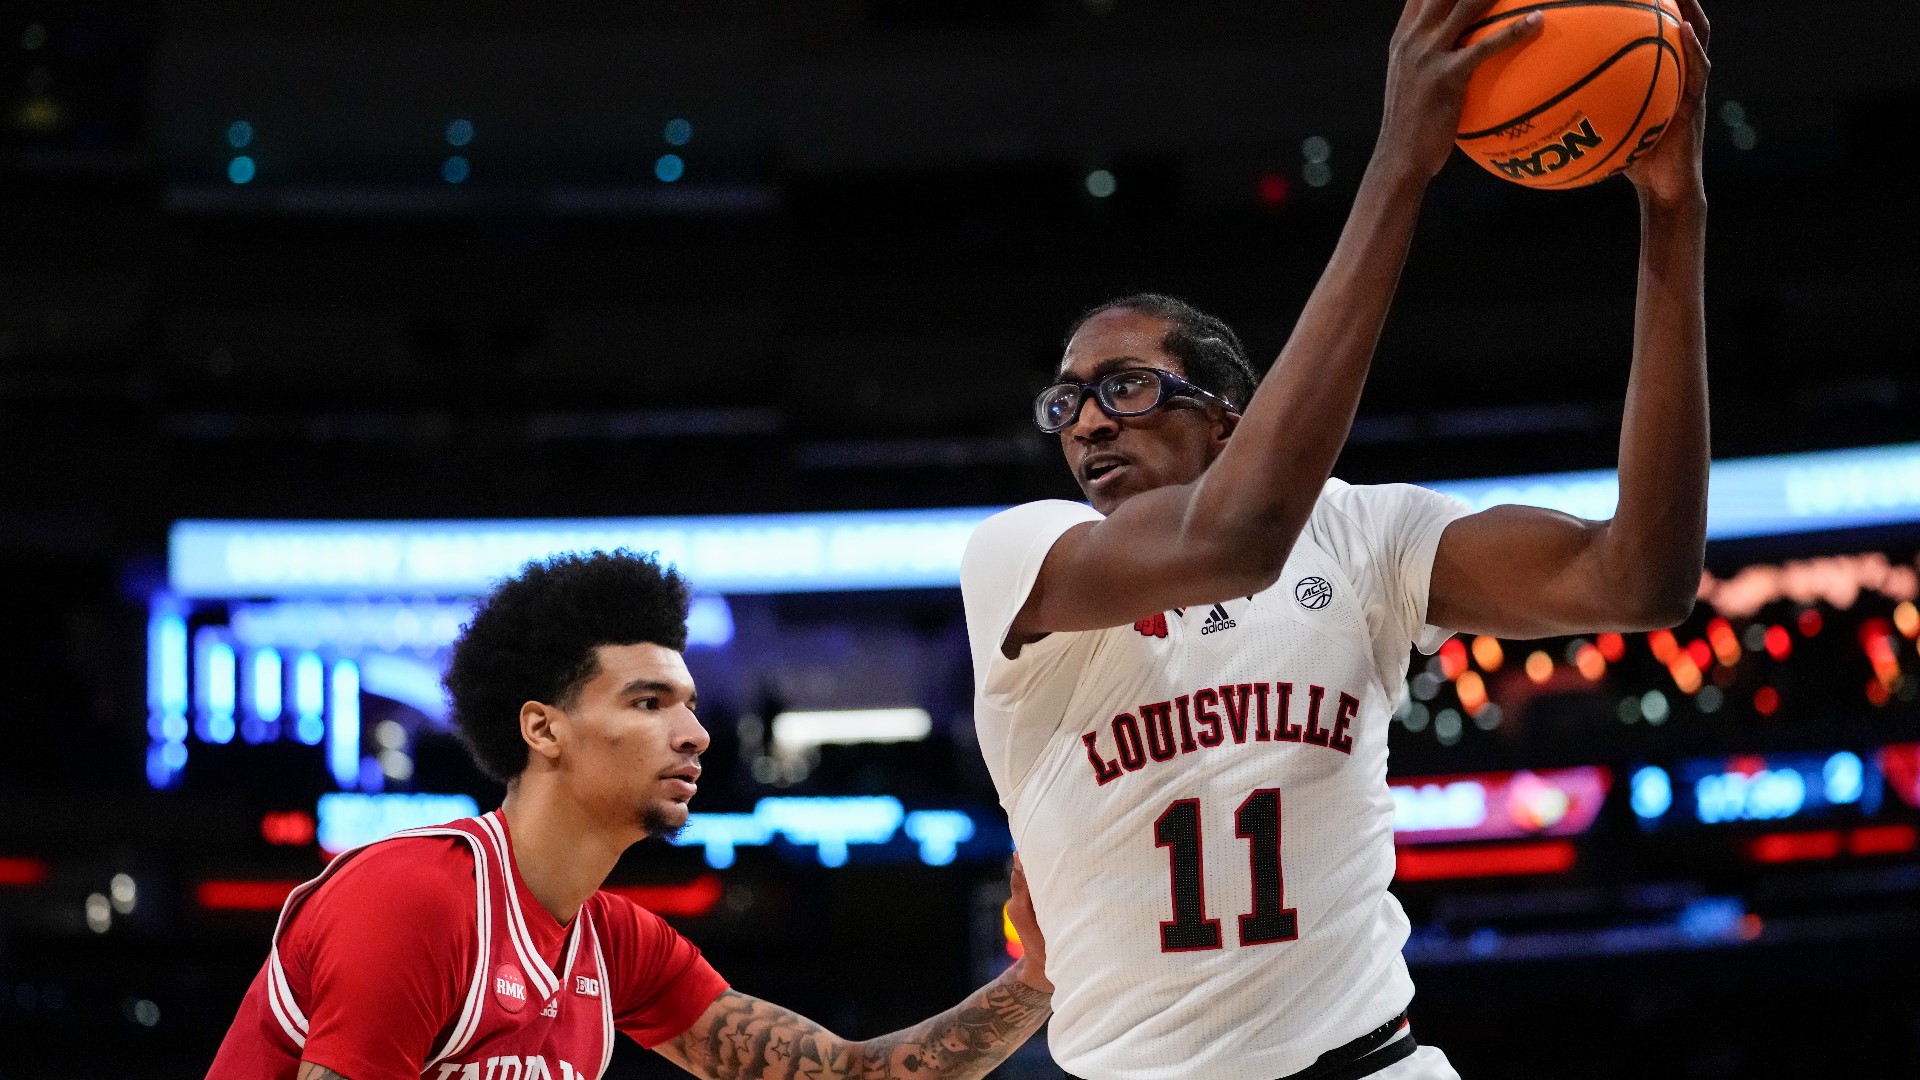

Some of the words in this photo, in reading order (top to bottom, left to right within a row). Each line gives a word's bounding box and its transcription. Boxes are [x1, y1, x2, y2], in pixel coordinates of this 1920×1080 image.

[1489, 117, 1603, 179] NCAA
[1300, 582, 1329, 600] ACC
[1201, 619, 1236, 635] adidas
[1081, 682, 1359, 786] LOUISVILLE
[1154, 787, 1299, 953] 11
[497, 977, 526, 1001] RMK
